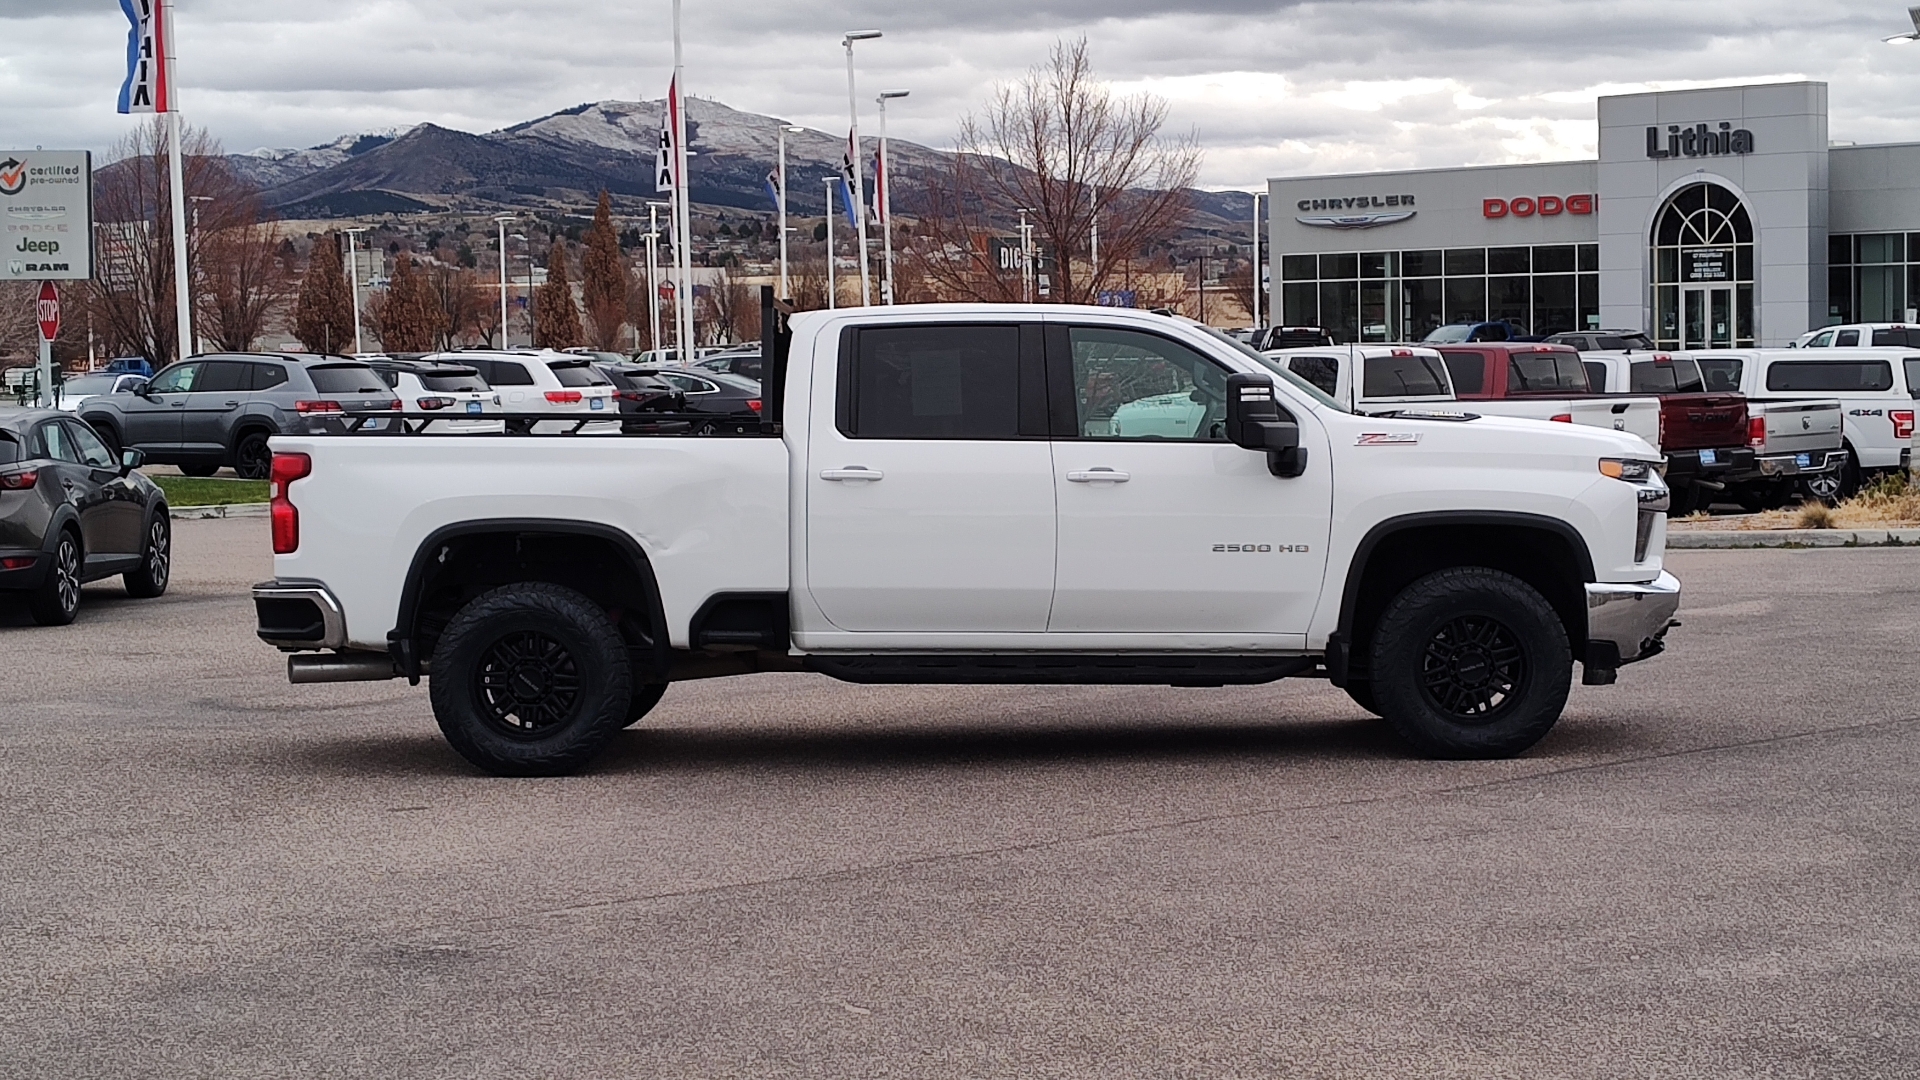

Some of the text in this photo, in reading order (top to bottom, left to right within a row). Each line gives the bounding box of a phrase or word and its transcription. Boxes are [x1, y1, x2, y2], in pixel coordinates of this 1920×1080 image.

[1646, 121, 1753, 158] Lithia
[30, 165, 79, 175] certified
[30, 176, 79, 185] pre-owned
[1297, 194, 1416, 211] CHRYSLER
[16, 237, 60, 255] Jeep
[25, 263, 69, 271] RAM
[39, 299, 57, 321] STOP
[1211, 544, 1309, 553] 2500 HD
